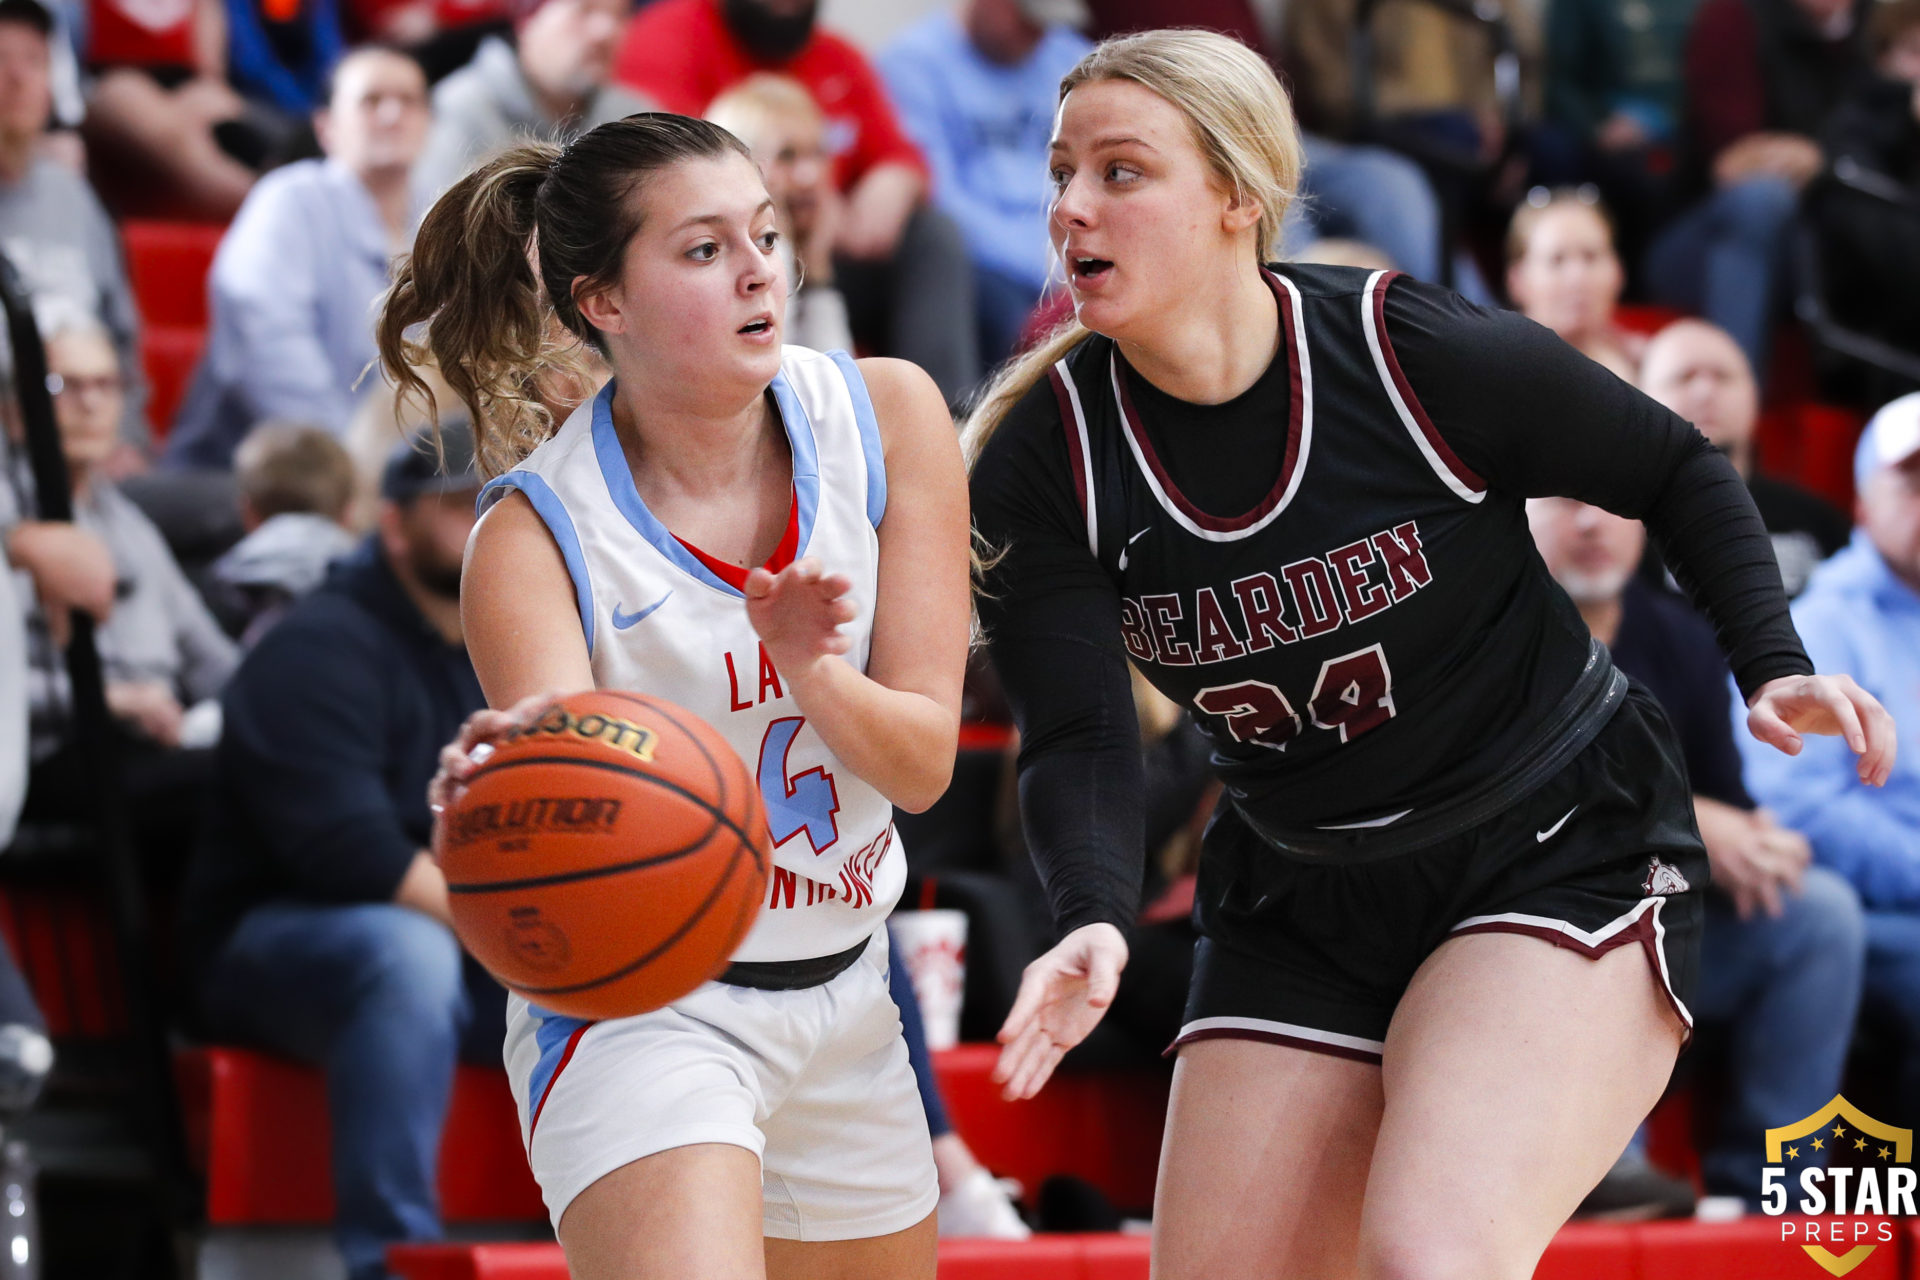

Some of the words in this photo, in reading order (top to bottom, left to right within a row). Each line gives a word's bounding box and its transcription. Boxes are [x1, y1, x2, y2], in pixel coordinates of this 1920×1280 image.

[1121, 520, 1433, 666] BEARDEN
[724, 640, 784, 712] LA
[1193, 642, 1397, 752] 24
[756, 716, 840, 856] 4
